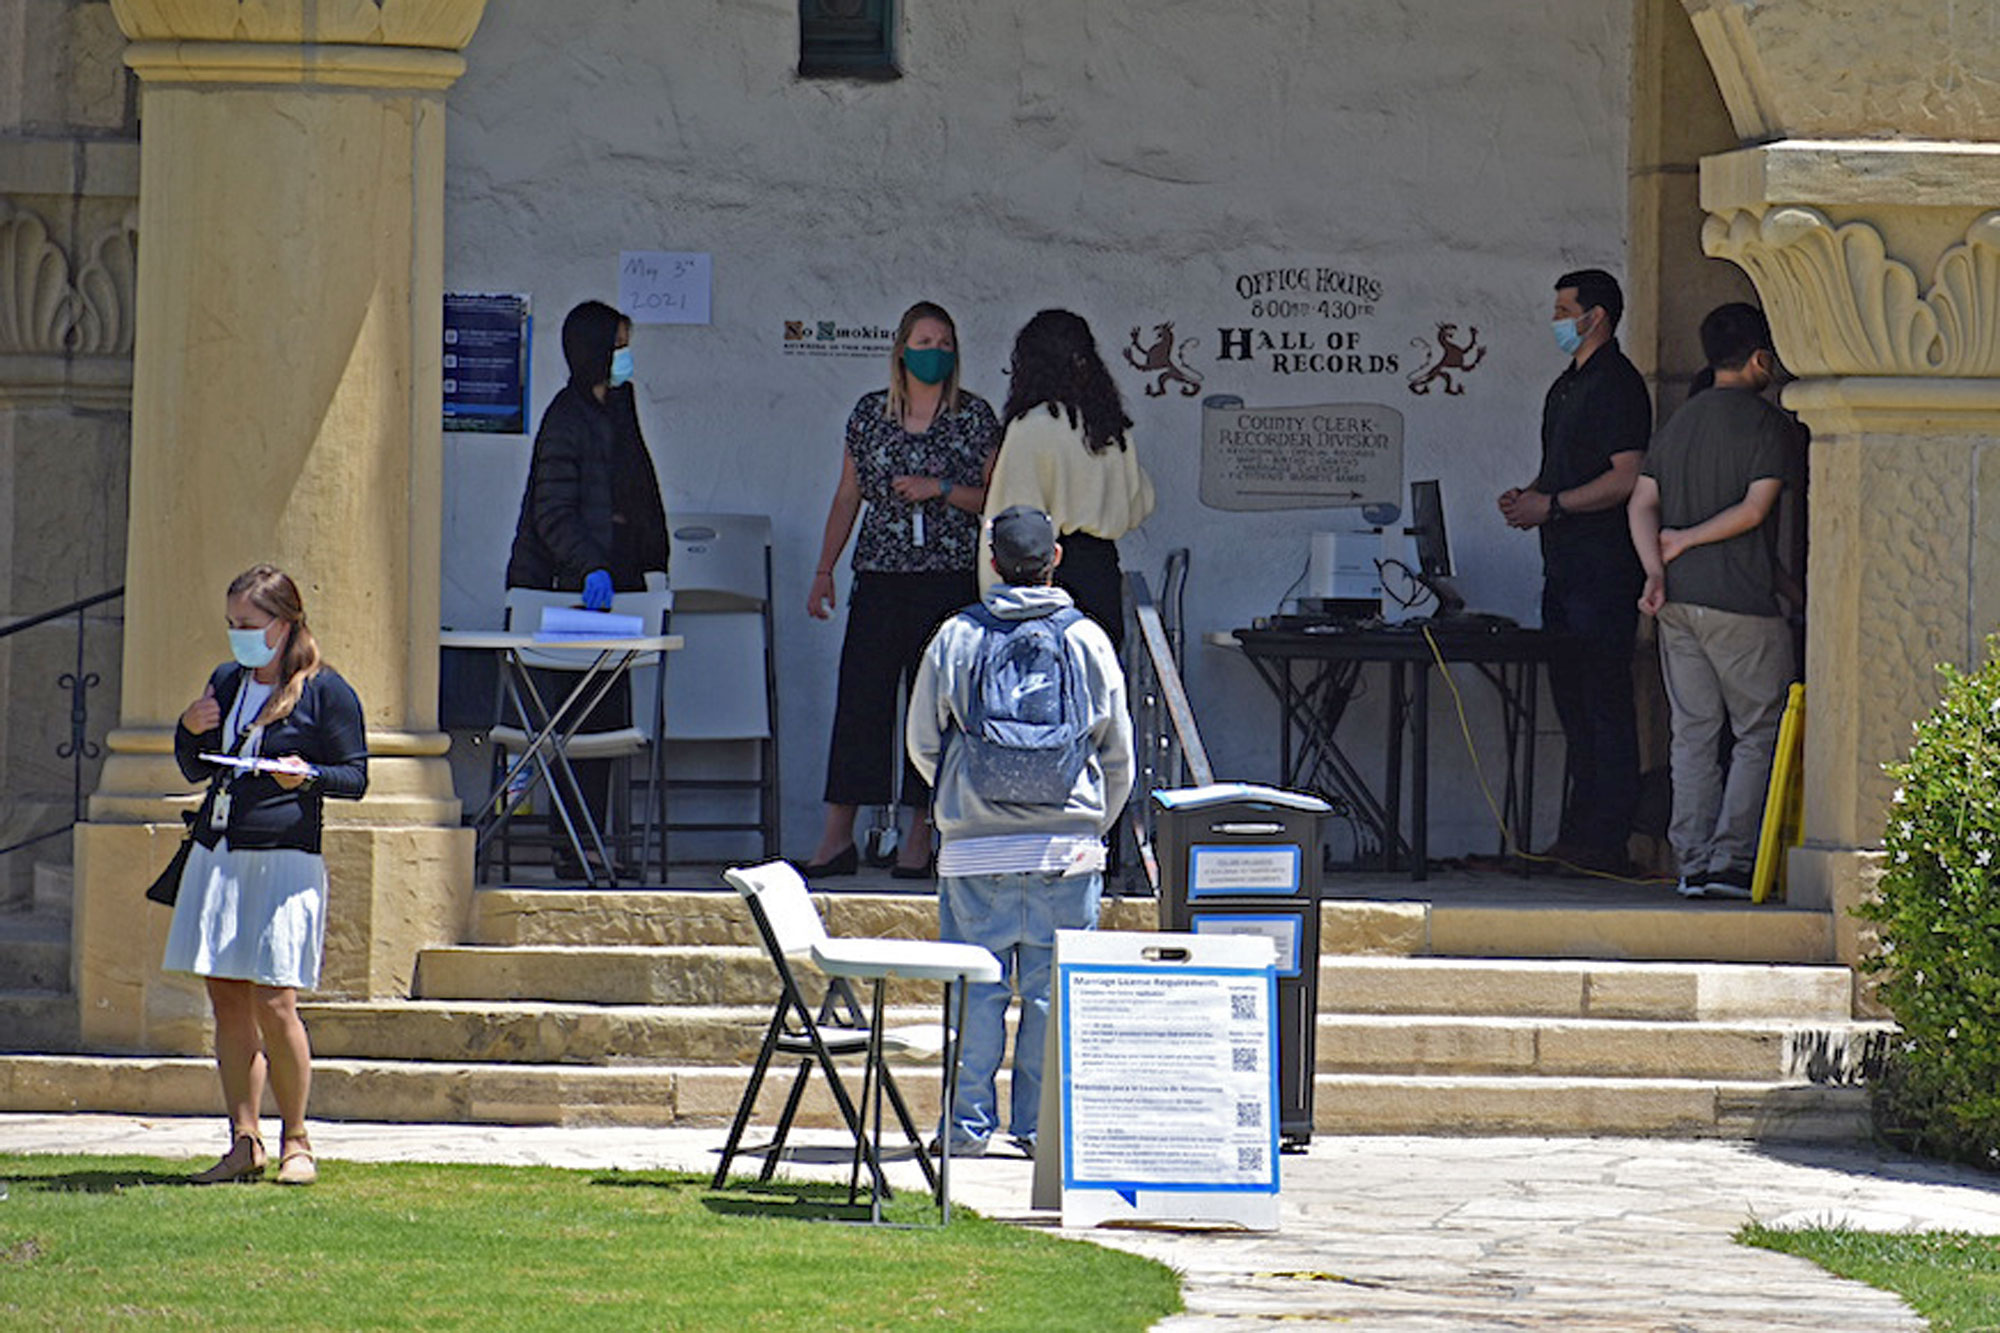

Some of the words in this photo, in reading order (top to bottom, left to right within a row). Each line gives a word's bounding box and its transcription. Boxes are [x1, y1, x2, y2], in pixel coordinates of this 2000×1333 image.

[623, 257, 659, 284] May
[1235, 268, 1311, 300] OFFICE
[1315, 267, 1384, 302] HOURS
[628, 290, 687, 310] 2021
[783, 321, 814, 341] No
[1216, 327, 1315, 361] HALL
[1326, 331, 1361, 351] OF
[1272, 353, 1400, 375] RECORDS
[1237, 414, 1305, 431] COUNTY
[1218, 429, 1313, 448] RECORDER
[1316, 431, 1390, 449] DIVISION
